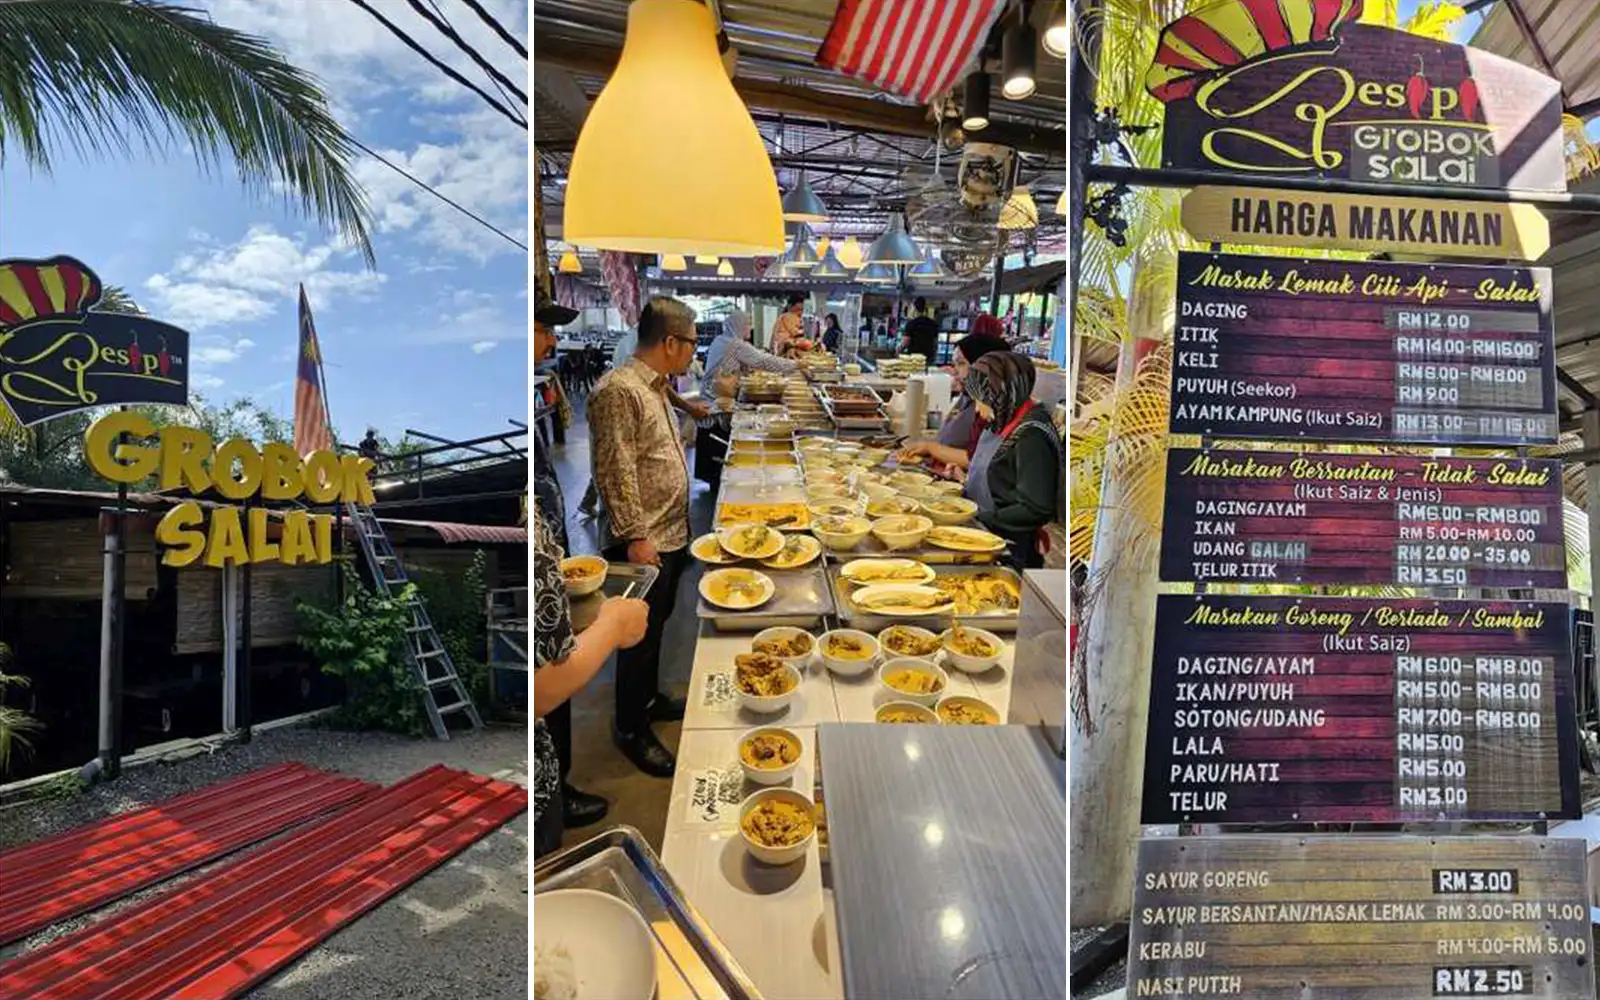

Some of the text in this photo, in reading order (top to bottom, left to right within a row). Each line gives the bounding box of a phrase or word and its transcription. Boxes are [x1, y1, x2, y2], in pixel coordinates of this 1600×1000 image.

[1231, 197, 1502, 247] HARGA MAKANAN
[1189, 266, 1275, 289] Masak
[1279, 270, 1355, 295] Lemak
[1362, 273, 1402, 297] Cili
[1405, 276, 1449, 304] Api
[1474, 279, 1544, 302] Salai
[1181, 302, 1248, 319] DAGING
[1180, 327, 1219, 343] ITIK
[1178, 352, 1219, 368] KELI
[1177, 378, 1228, 394] PUYUH
[1231, 381, 1297, 398] (Seekor)
[1306, 411, 1341, 427] (Ikut
[1346, 413, 1382, 428] Saiz)
[84, 410, 377, 506] GROBOK
[1180, 455, 1286, 478] Masakan
[1289, 458, 1398, 482] Bersantan
[1421, 462, 1477, 484] Tidak
[1487, 463, 1550, 487] Salai
[1294, 484, 1443, 502] (Ikut Saiz & Jenis)
[1196, 501, 1306, 517] DAGING/AYAM
[155, 502, 332, 568] SALAI
[1194, 521, 1235, 536] IKAN
[1193, 541, 1245, 556] UDANG
[1192, 562, 1237, 577] TELUR
[1240, 563, 1277, 578] ITIK
[1184, 604, 1280, 626] Masakan
[1285, 605, 1353, 636] Goreng
[1322, 635, 1411, 652] (Ikut Saiz)
[1177, 657, 1315, 675] DAGING/AYAM
[1175, 683, 1294, 701] IKAN/PUYUH
[1174, 709, 1326, 728] SOTONG/UDANG
[1172, 736, 1224, 755] LALA
[1170, 763, 1280, 783] PARU/HATI
[1169, 792, 1228, 811] TELUR
[1145, 871, 1198, 890] SAYUR
[1203, 871, 1269, 888] GORENG
[1142, 906, 1197, 924] SAYUR
[1200, 904, 1368, 922] BERSANTAN/MASAK
[1372, 904, 1425, 921] LEMAK
[1547, 904, 1584, 921] 4.00
[1139, 941, 1206, 961] KERABU
[1548, 938, 1586, 955] 5.00
[1137, 977, 1184, 997] NASI
[1188, 976, 1242, 994] PUTIH
